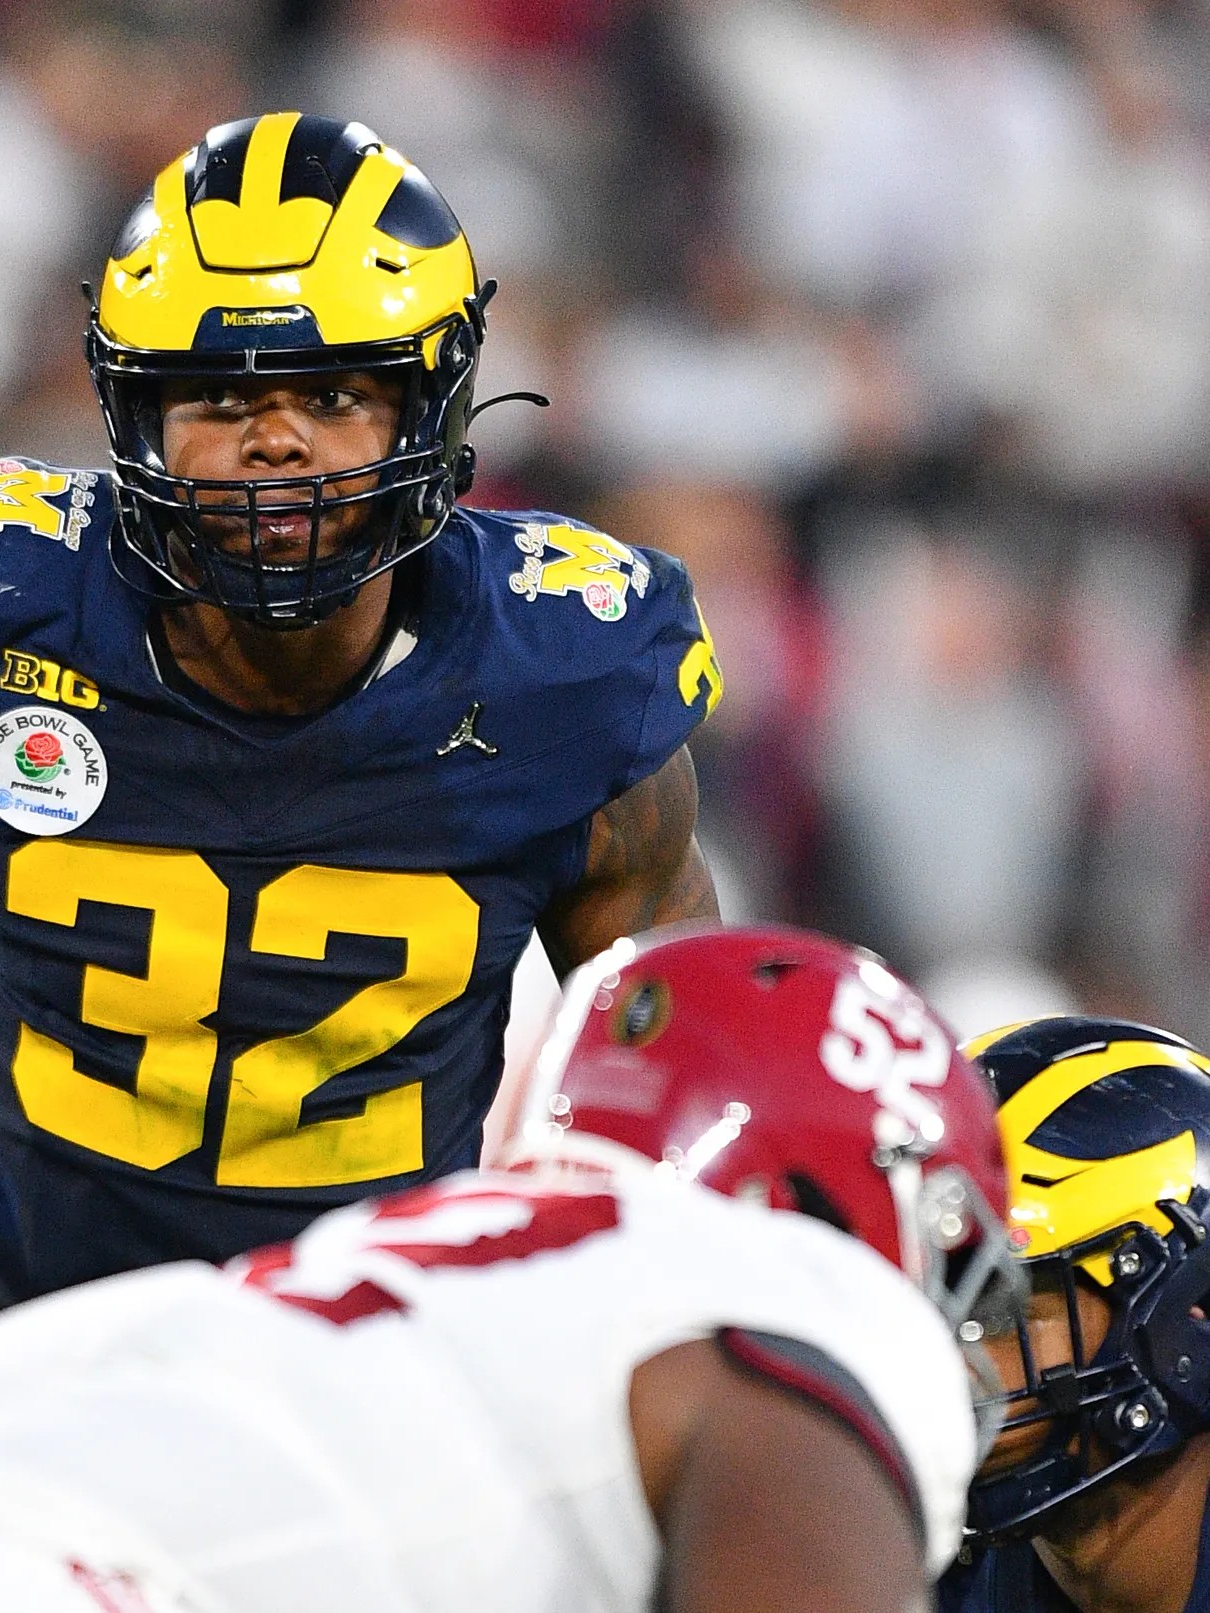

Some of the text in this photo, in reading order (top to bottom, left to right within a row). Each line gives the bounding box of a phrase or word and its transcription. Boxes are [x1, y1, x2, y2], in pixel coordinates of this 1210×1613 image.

[537, 523, 634, 600] M
[15, 715, 70, 737] BOWL
[73, 733, 100, 787] GAME
[10, 781, 68, 799] presented by
[14, 799, 79, 822] Prudential
[5, 837, 480, 1188] 32
